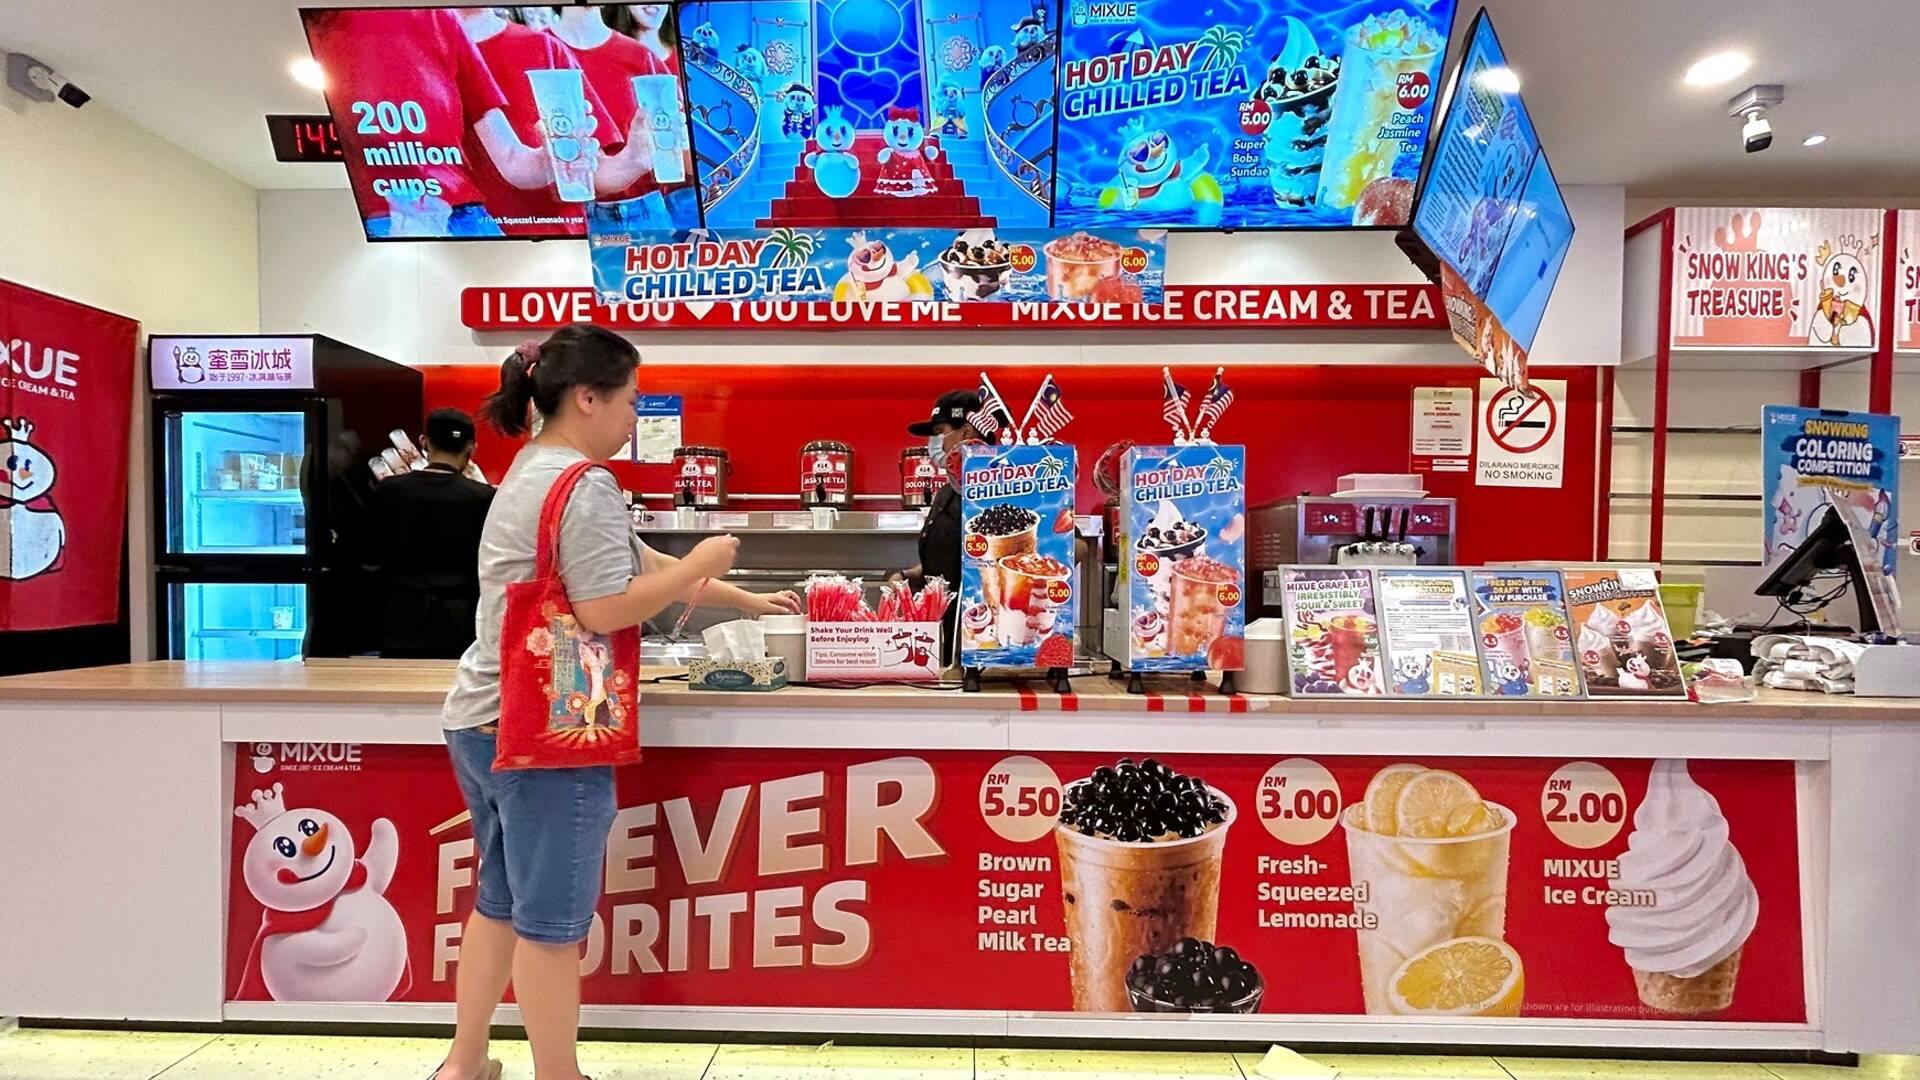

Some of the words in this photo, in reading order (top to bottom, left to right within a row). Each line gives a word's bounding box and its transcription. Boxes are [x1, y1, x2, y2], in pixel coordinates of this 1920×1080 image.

[1090, 3, 1136, 17] MIXUE
[1065, 53, 1127, 88] HOT
[1133, 41, 1197, 75] DAY
[1398, 75, 1414, 84] RM
[1064, 80, 1184, 120] CHILLED
[1194, 66, 1248, 98] TEA
[1399, 85, 1429, 99] 6.00
[1239, 102, 1254, 111] RM
[351, 100, 426, 135] 200
[1241, 112, 1271, 126] 5.00
[1392, 113, 1424, 125] Peach
[1378, 127, 1421, 138] Jasmine
[362, 143, 463, 166] million
[1234, 140, 1265, 152] Super
[1400, 141, 1418, 152] Tea
[1232, 153, 1258, 163] Boba
[1231, 166, 1269, 177] Sundae
[373, 175, 442, 198] cups
[626, 244, 691, 271] HOT
[698, 240, 765, 267] DAY
[1011, 254, 1034, 265] 5.00
[1123, 257, 1145, 267] 6.00
[1687, 253, 1740, 280] SNOW
[1746, 253, 1807, 281] KING'S
[625, 270, 752, 300] CHILLED
[761, 266, 823, 293] TEA
[481, 293, 490, 322] I
[499, 292, 592, 322] LOVE
[603, 301, 676, 322] YOU
[729, 302, 798, 322] YOU
[808, 301, 901, 322] LOVE
[912, 301, 962, 321] ME
[1012, 302, 1122, 321] MIXUE
[1132, 290, 1183, 321] ICE
[1194, 289, 1318, 320] CREAM
[1327, 290, 1352, 320] &
[1363, 289, 1435, 320] TEA
[1687, 289, 1783, 316] TREASURE
[208, 348, 292, 370] 蜜雪冰城
[18, 380, 48, 396] CREAM
[50, 387, 59, 397] &
[60, 389, 75, 400] TEA
[1804, 420, 1869, 438] SNOWKING
[1796, 438, 1873, 461] COLORING
[966, 469, 1000, 485] HOT
[1003, 464, 1037, 480] DAY
[1479, 461, 1519, 469] DILARANG
[1520, 462, 1561, 471] MEROKOK
[1485, 470, 1501, 479] NO
[1503, 471, 1553, 480] SMOKING
[1797, 459, 1870, 475] COMPETITION
[1135, 471, 1169, 487] HOT
[1173, 466, 1207, 481] DAY
[966, 481, 1033, 500] CHILLED
[1037, 477, 1069, 492] TEA
[1135, 482, 1203, 502] CHILLED
[1207, 478, 1238, 493] TEA
[967, 543, 988, 551] 5.50
[1137, 562, 1158, 571] 5.00
[1049, 589, 1070, 597] 5.00
[1287, 582, 1317, 591] MIXUE
[1319, 581, 1350, 591] GRAPE
[1352, 580, 1369, 588] TEA
[1568, 578, 1621, 598] SNOWKIN
[1219, 592, 1239, 600] 6.00
[1297, 591, 1360, 601] IRRESISTIBLY
[1295, 602, 1322, 610] SOUR
[1323, 601, 1330, 609] &
[1333, 601, 1364, 609] SWEET
[1555, 629, 1569, 638] 4.5
[1617, 623, 1631, 632] 5.5
[836, 636, 869, 644] Enjoying
[1483, 637, 1497, 646] 4.5
[1585, 653, 1599, 662] 5.5
[281, 742, 362, 762] MIXUE
[987, 774, 1010, 785] RM
[1264, 777, 1287, 787] RM
[1549, 780, 1571, 791] RM
[984, 787, 1060, 817] 5.50
[1262, 789, 1339, 819] 3.00
[1546, 793, 1623, 823] 2.00
[436, 757, 947, 915] FEVER
[978, 853, 1051, 872] Brown
[1258, 855, 1328, 875] Fresh-
[1544, 860, 1620, 878] MIXUE
[978, 880, 1044, 902] Sugar
[1258, 881, 1369, 905] Squeezed
[1544, 886, 1577, 904] Ice
[1582, 886, 1656, 906] Cream
[978, 906, 1037, 925] Pearl
[1258, 909, 1378, 929] Lemonade
[433, 880, 870, 982] FRITES
[978, 932, 1027, 951] Milk
[1031, 933, 1071, 952] Tea
[1523, 1002, 1552, 1011] shown
[1586, 1003, 1637, 1013] illustration
